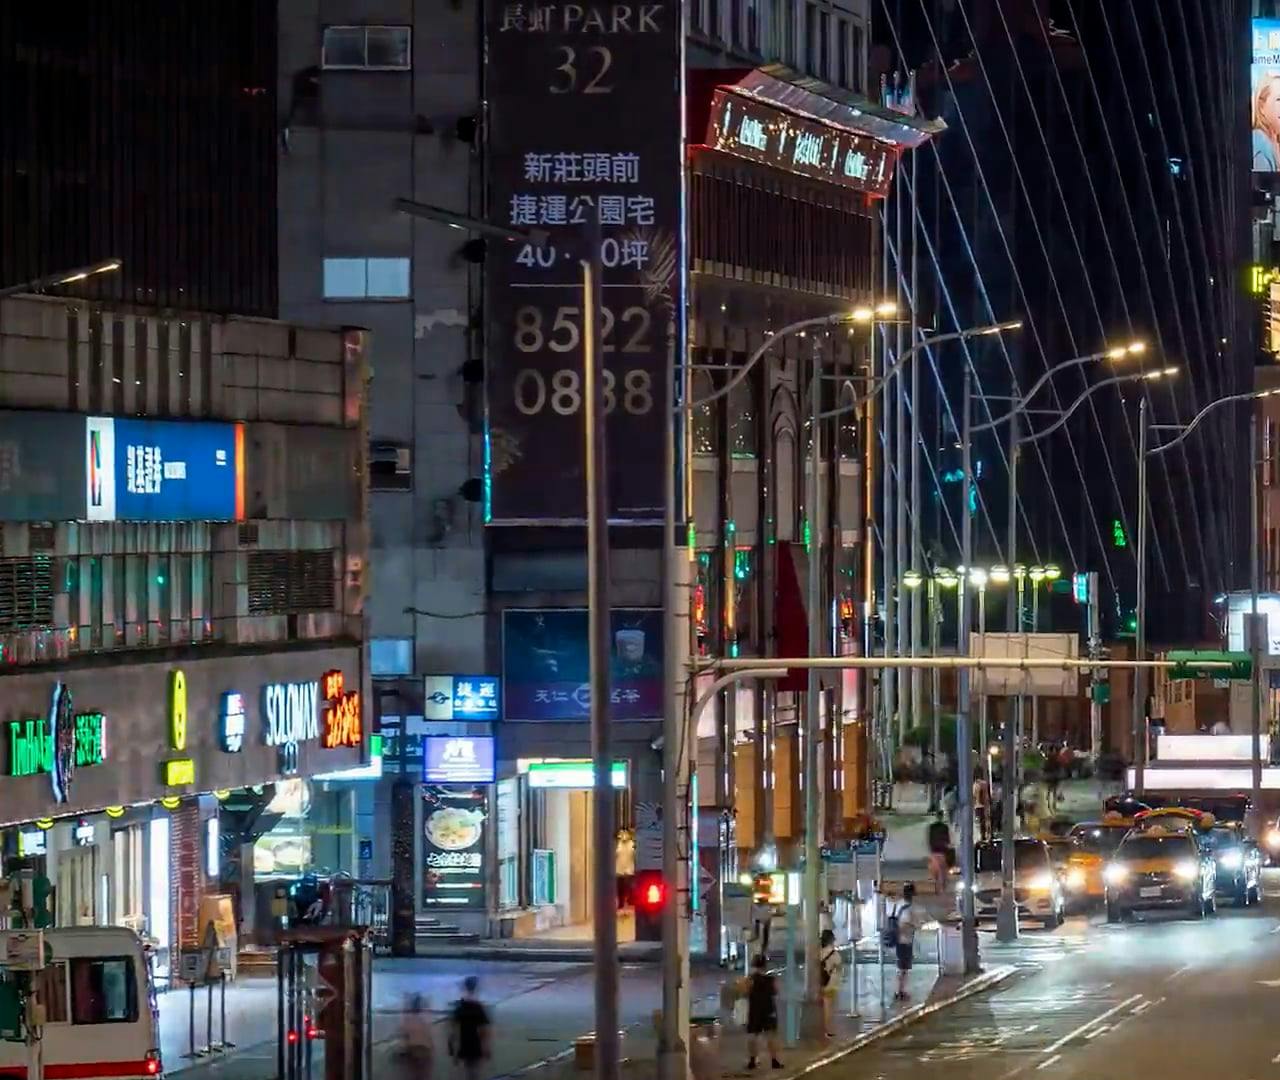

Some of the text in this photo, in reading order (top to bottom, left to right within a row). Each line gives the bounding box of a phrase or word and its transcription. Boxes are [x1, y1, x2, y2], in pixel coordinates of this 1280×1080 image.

[560, 4, 664, 33] PARK
[549, 46, 615, 94] 32
[524, 152, 641, 183] 新莊頭前
[509, 194, 656, 226] 捷運公園宅
